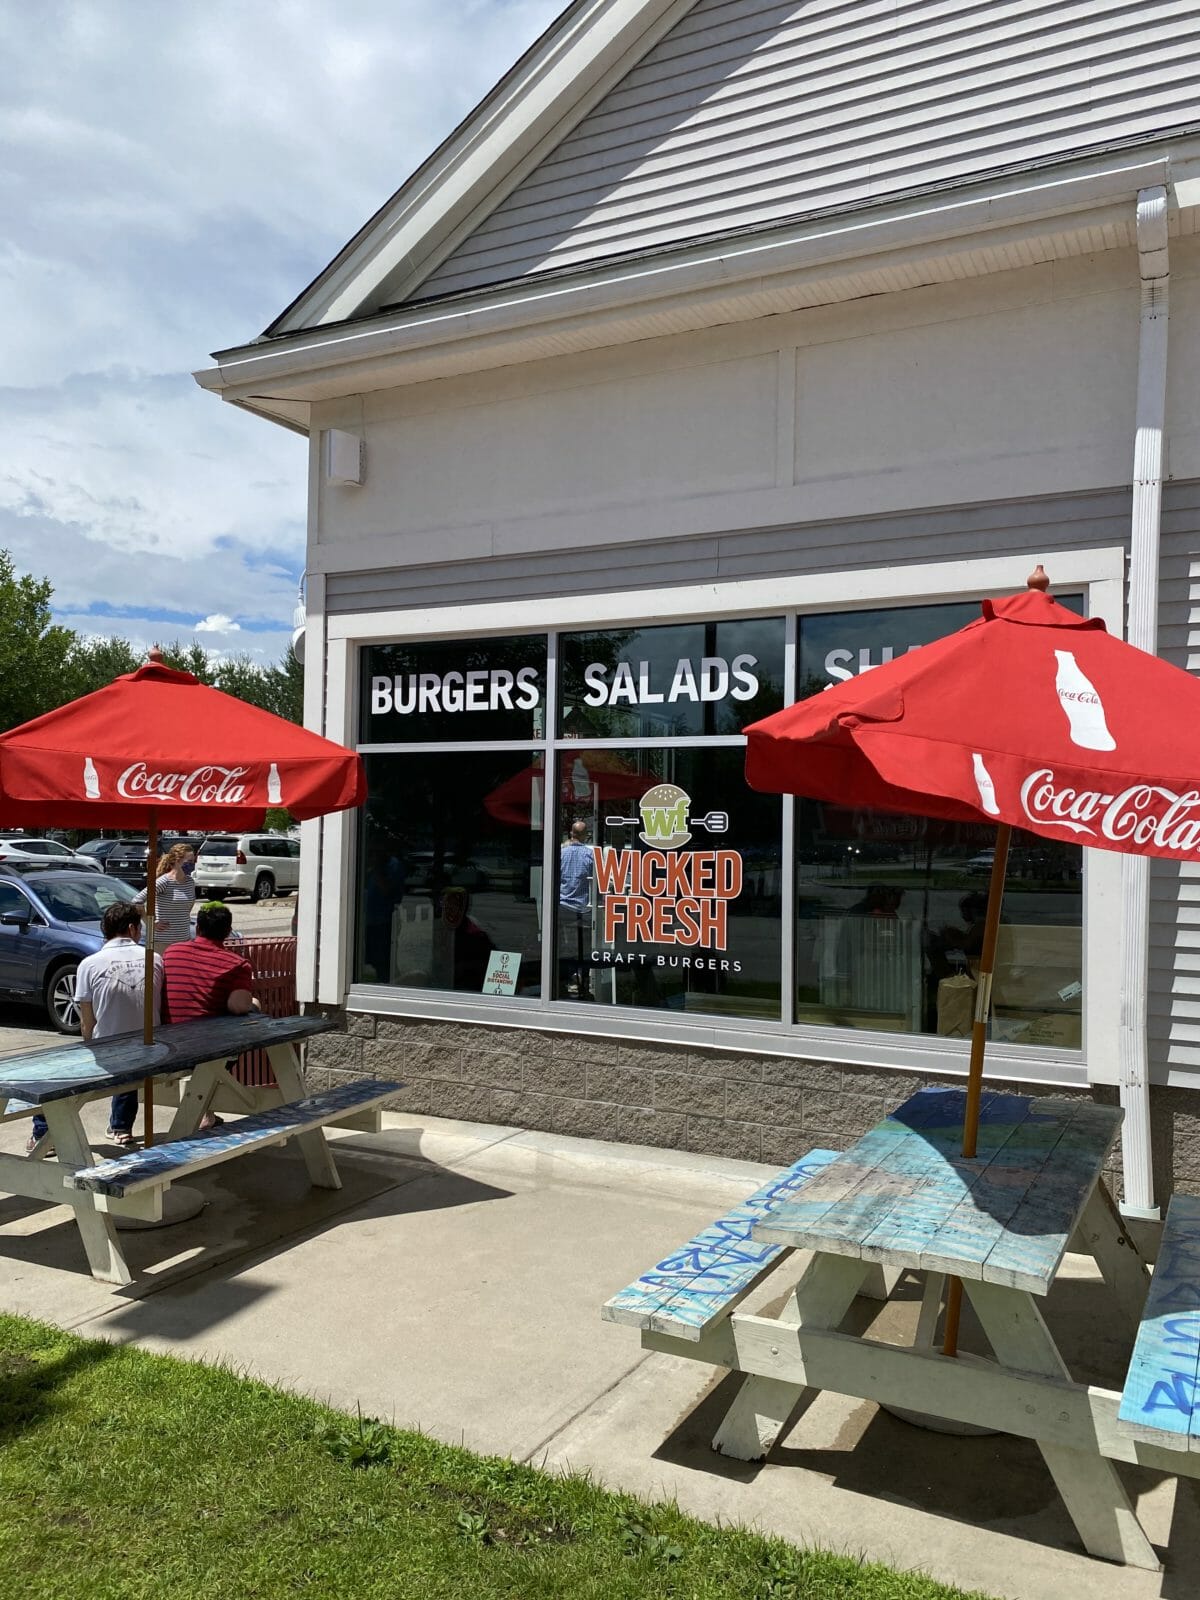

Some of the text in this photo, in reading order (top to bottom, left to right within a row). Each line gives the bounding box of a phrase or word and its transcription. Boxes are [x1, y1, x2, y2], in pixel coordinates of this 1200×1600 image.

[371, 667, 539, 715] BURGERS
[584, 654, 759, 707] SALADS
[117, 762, 250, 804] Coca-Cola
[1020, 768, 1200, 851] Coca-Cola
[593, 846, 743, 899] WICKED
[604, 895, 728, 951] FRESH
[591, 951, 742, 972] CRAFT BURGERS
